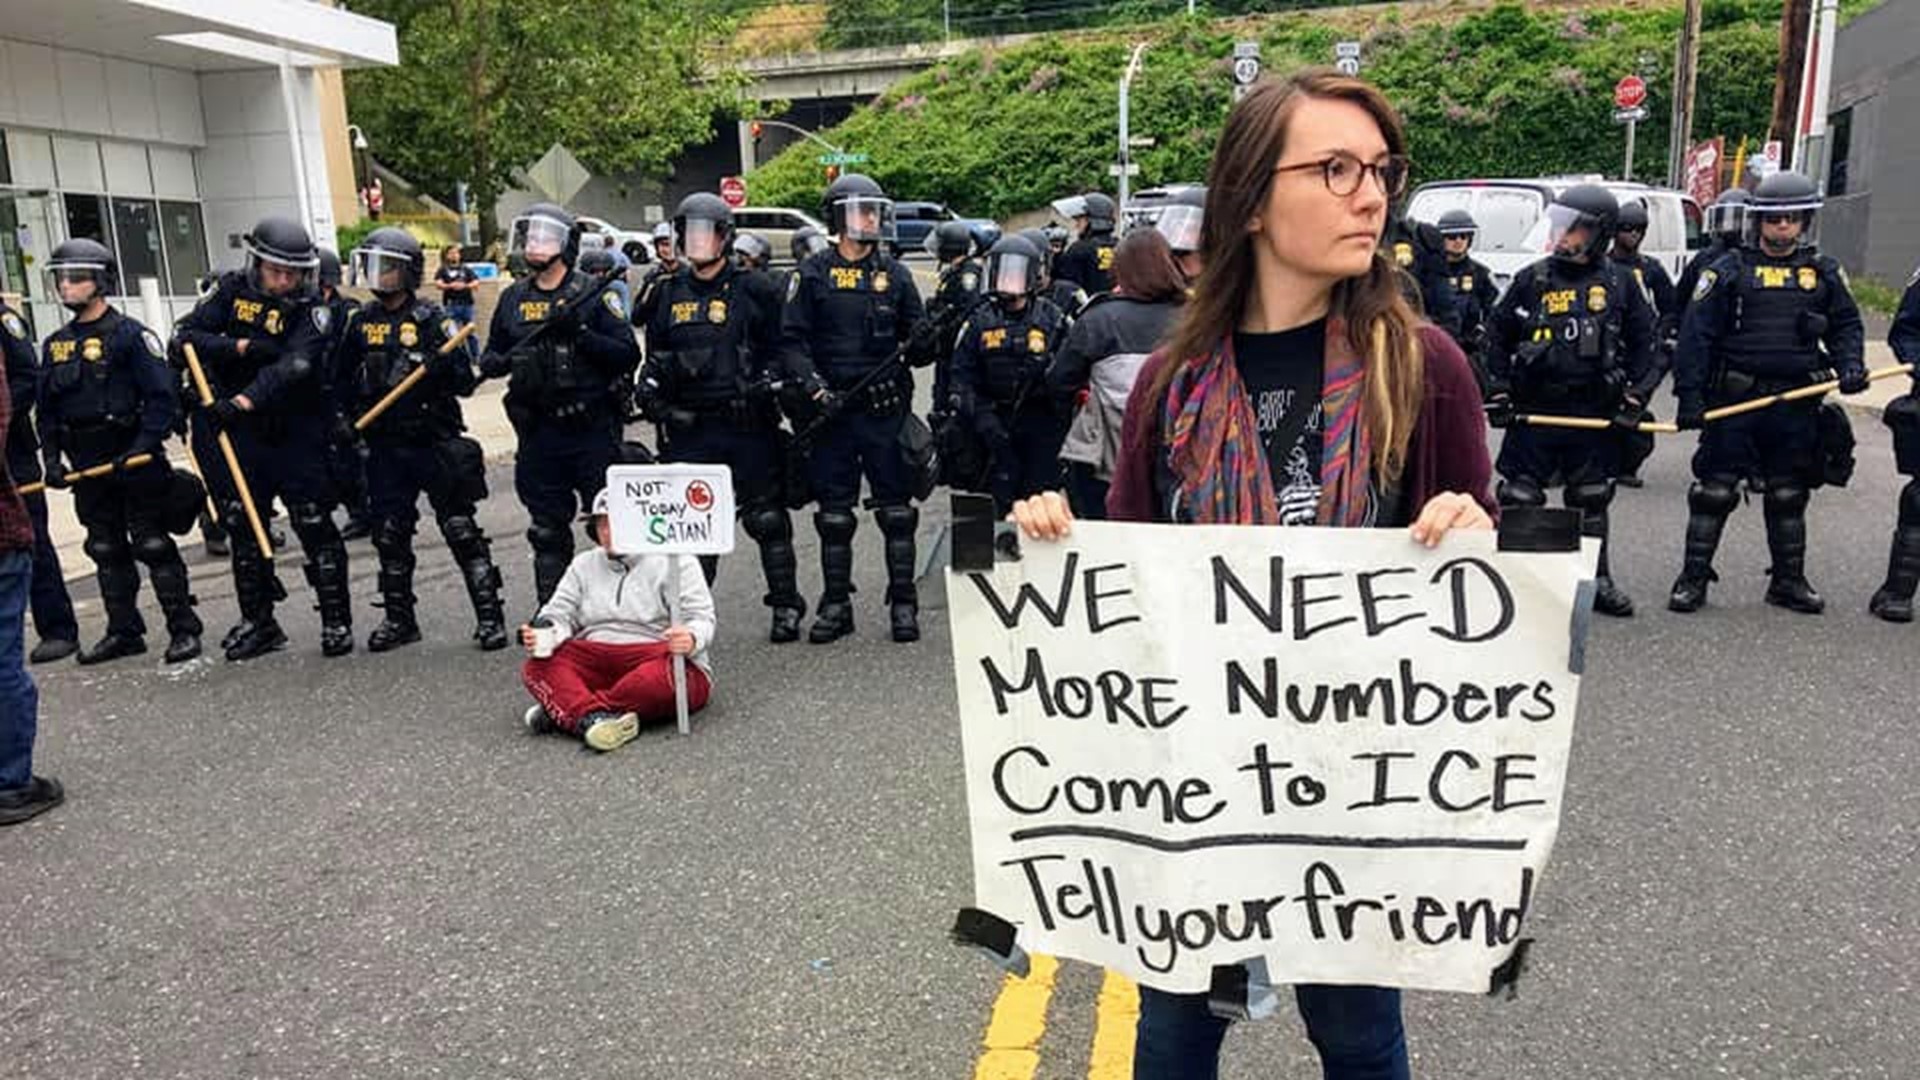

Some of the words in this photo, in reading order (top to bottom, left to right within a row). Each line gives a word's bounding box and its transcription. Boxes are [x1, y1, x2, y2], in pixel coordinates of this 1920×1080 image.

[1617, 84, 1644, 98] STOP
[832, 267, 863, 279] POLICE
[1542, 289, 1576, 301] POLICE
[362, 323, 391, 333] POLICE
[625, 481, 668, 498] NOT
[635, 500, 687, 519] TODAY
[647, 513, 712, 545] SATAN!
[967, 552, 1140, 634] WE
[1212, 554, 1515, 643] NEED
[980, 647, 1188, 729] MORE
[1226, 657, 1556, 726] Numbers
[992, 746, 1228, 824] Come
[1237, 743, 1327, 815] to
[1347, 749, 1546, 813] ICE
[1000, 854, 1126, 945] Tell
[1134, 893, 1285, 973] your
[1293, 861, 1534, 946] friend
